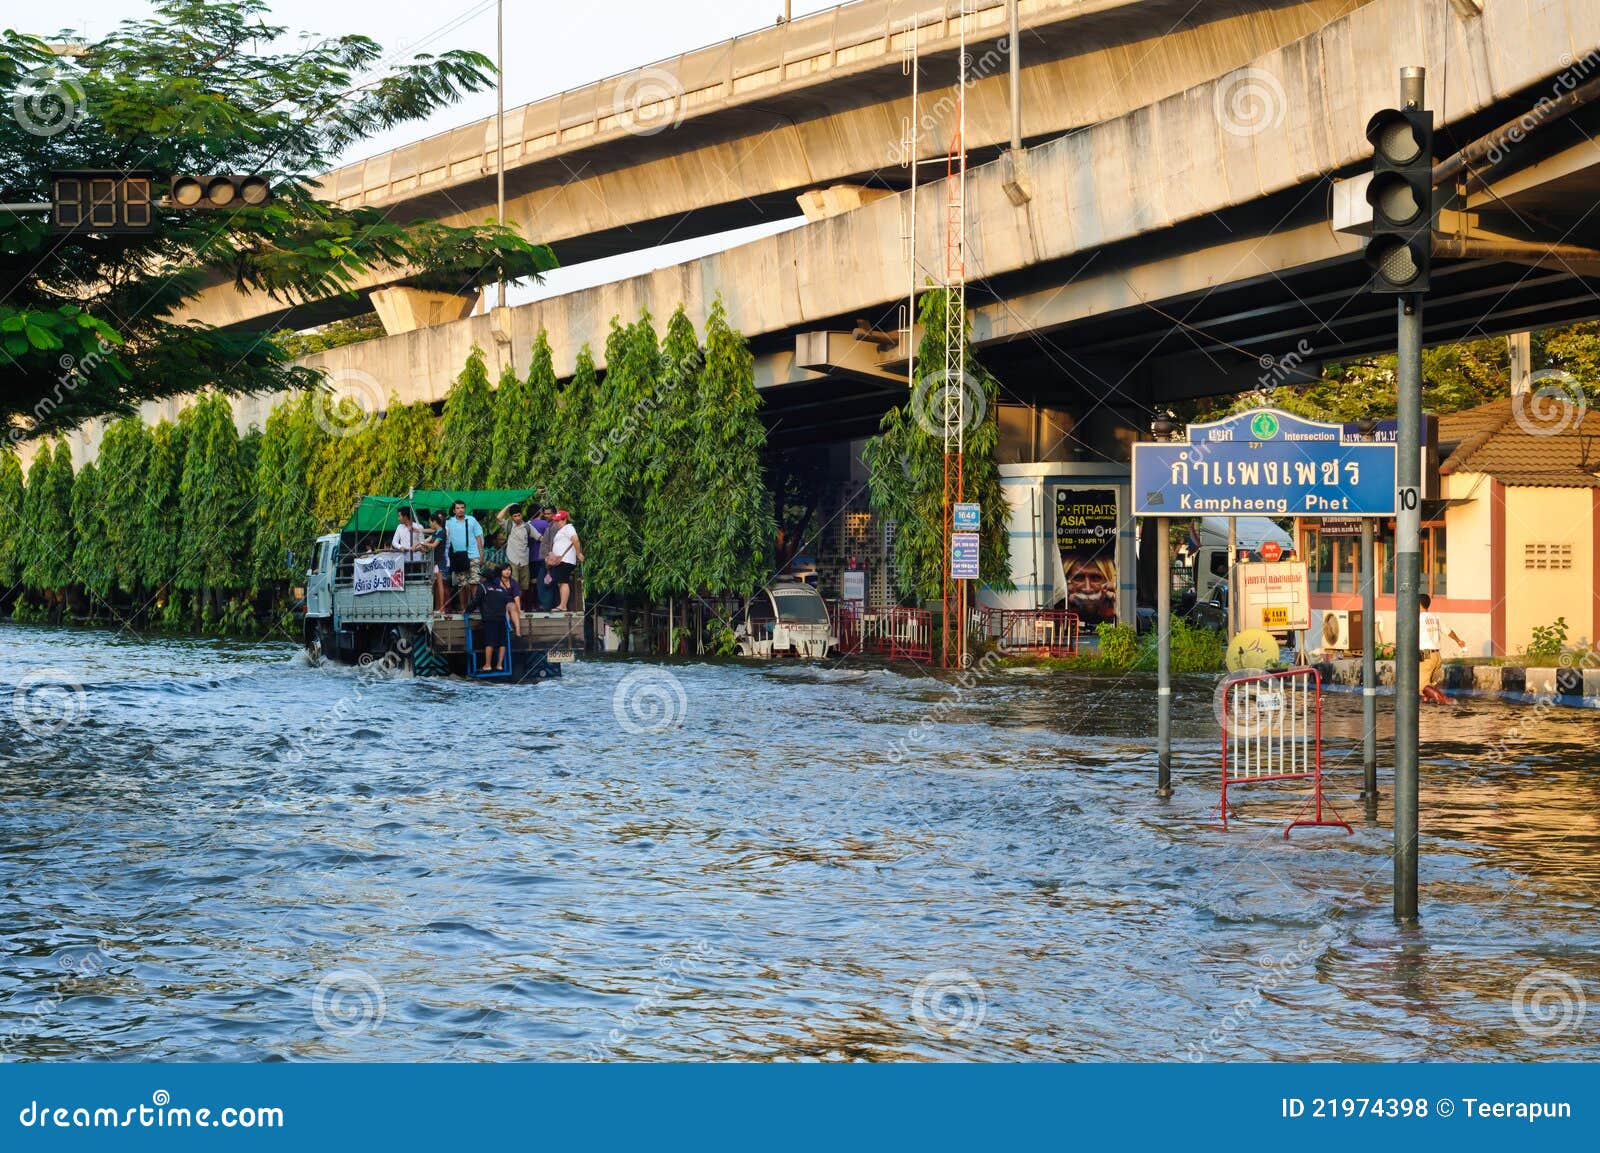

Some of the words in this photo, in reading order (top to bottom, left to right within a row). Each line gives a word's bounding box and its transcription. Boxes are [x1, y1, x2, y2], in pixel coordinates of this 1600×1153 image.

[1284, 431, 1335, 441] Intersection
[1171, 452, 1360, 486] กำแพงเพชร
[1180, 494, 1287, 512] Kamphaeng
[1305, 494, 1349, 509] Phet
[1398, 488, 1417, 510] 10
[1060, 515, 1086, 526] ASIA
